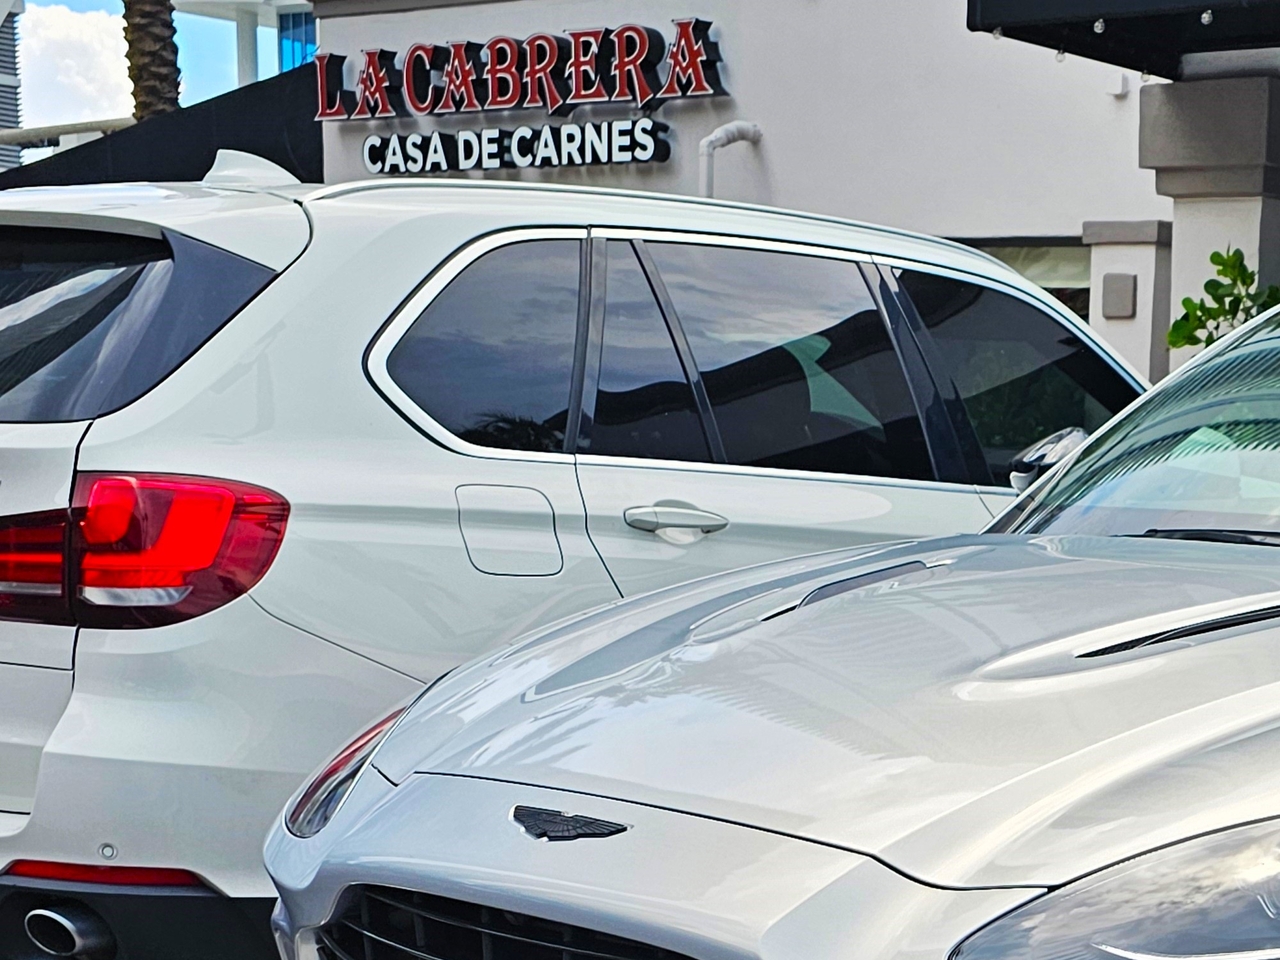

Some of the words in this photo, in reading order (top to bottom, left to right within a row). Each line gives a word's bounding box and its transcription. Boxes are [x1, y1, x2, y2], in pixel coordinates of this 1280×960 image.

[314, 47, 397, 120] LA
[403, 17, 715, 116] CABRERA
[363, 130, 448, 174] CASA
[458, 128, 500, 169] DE
[511, 118, 655, 167] CARNES
